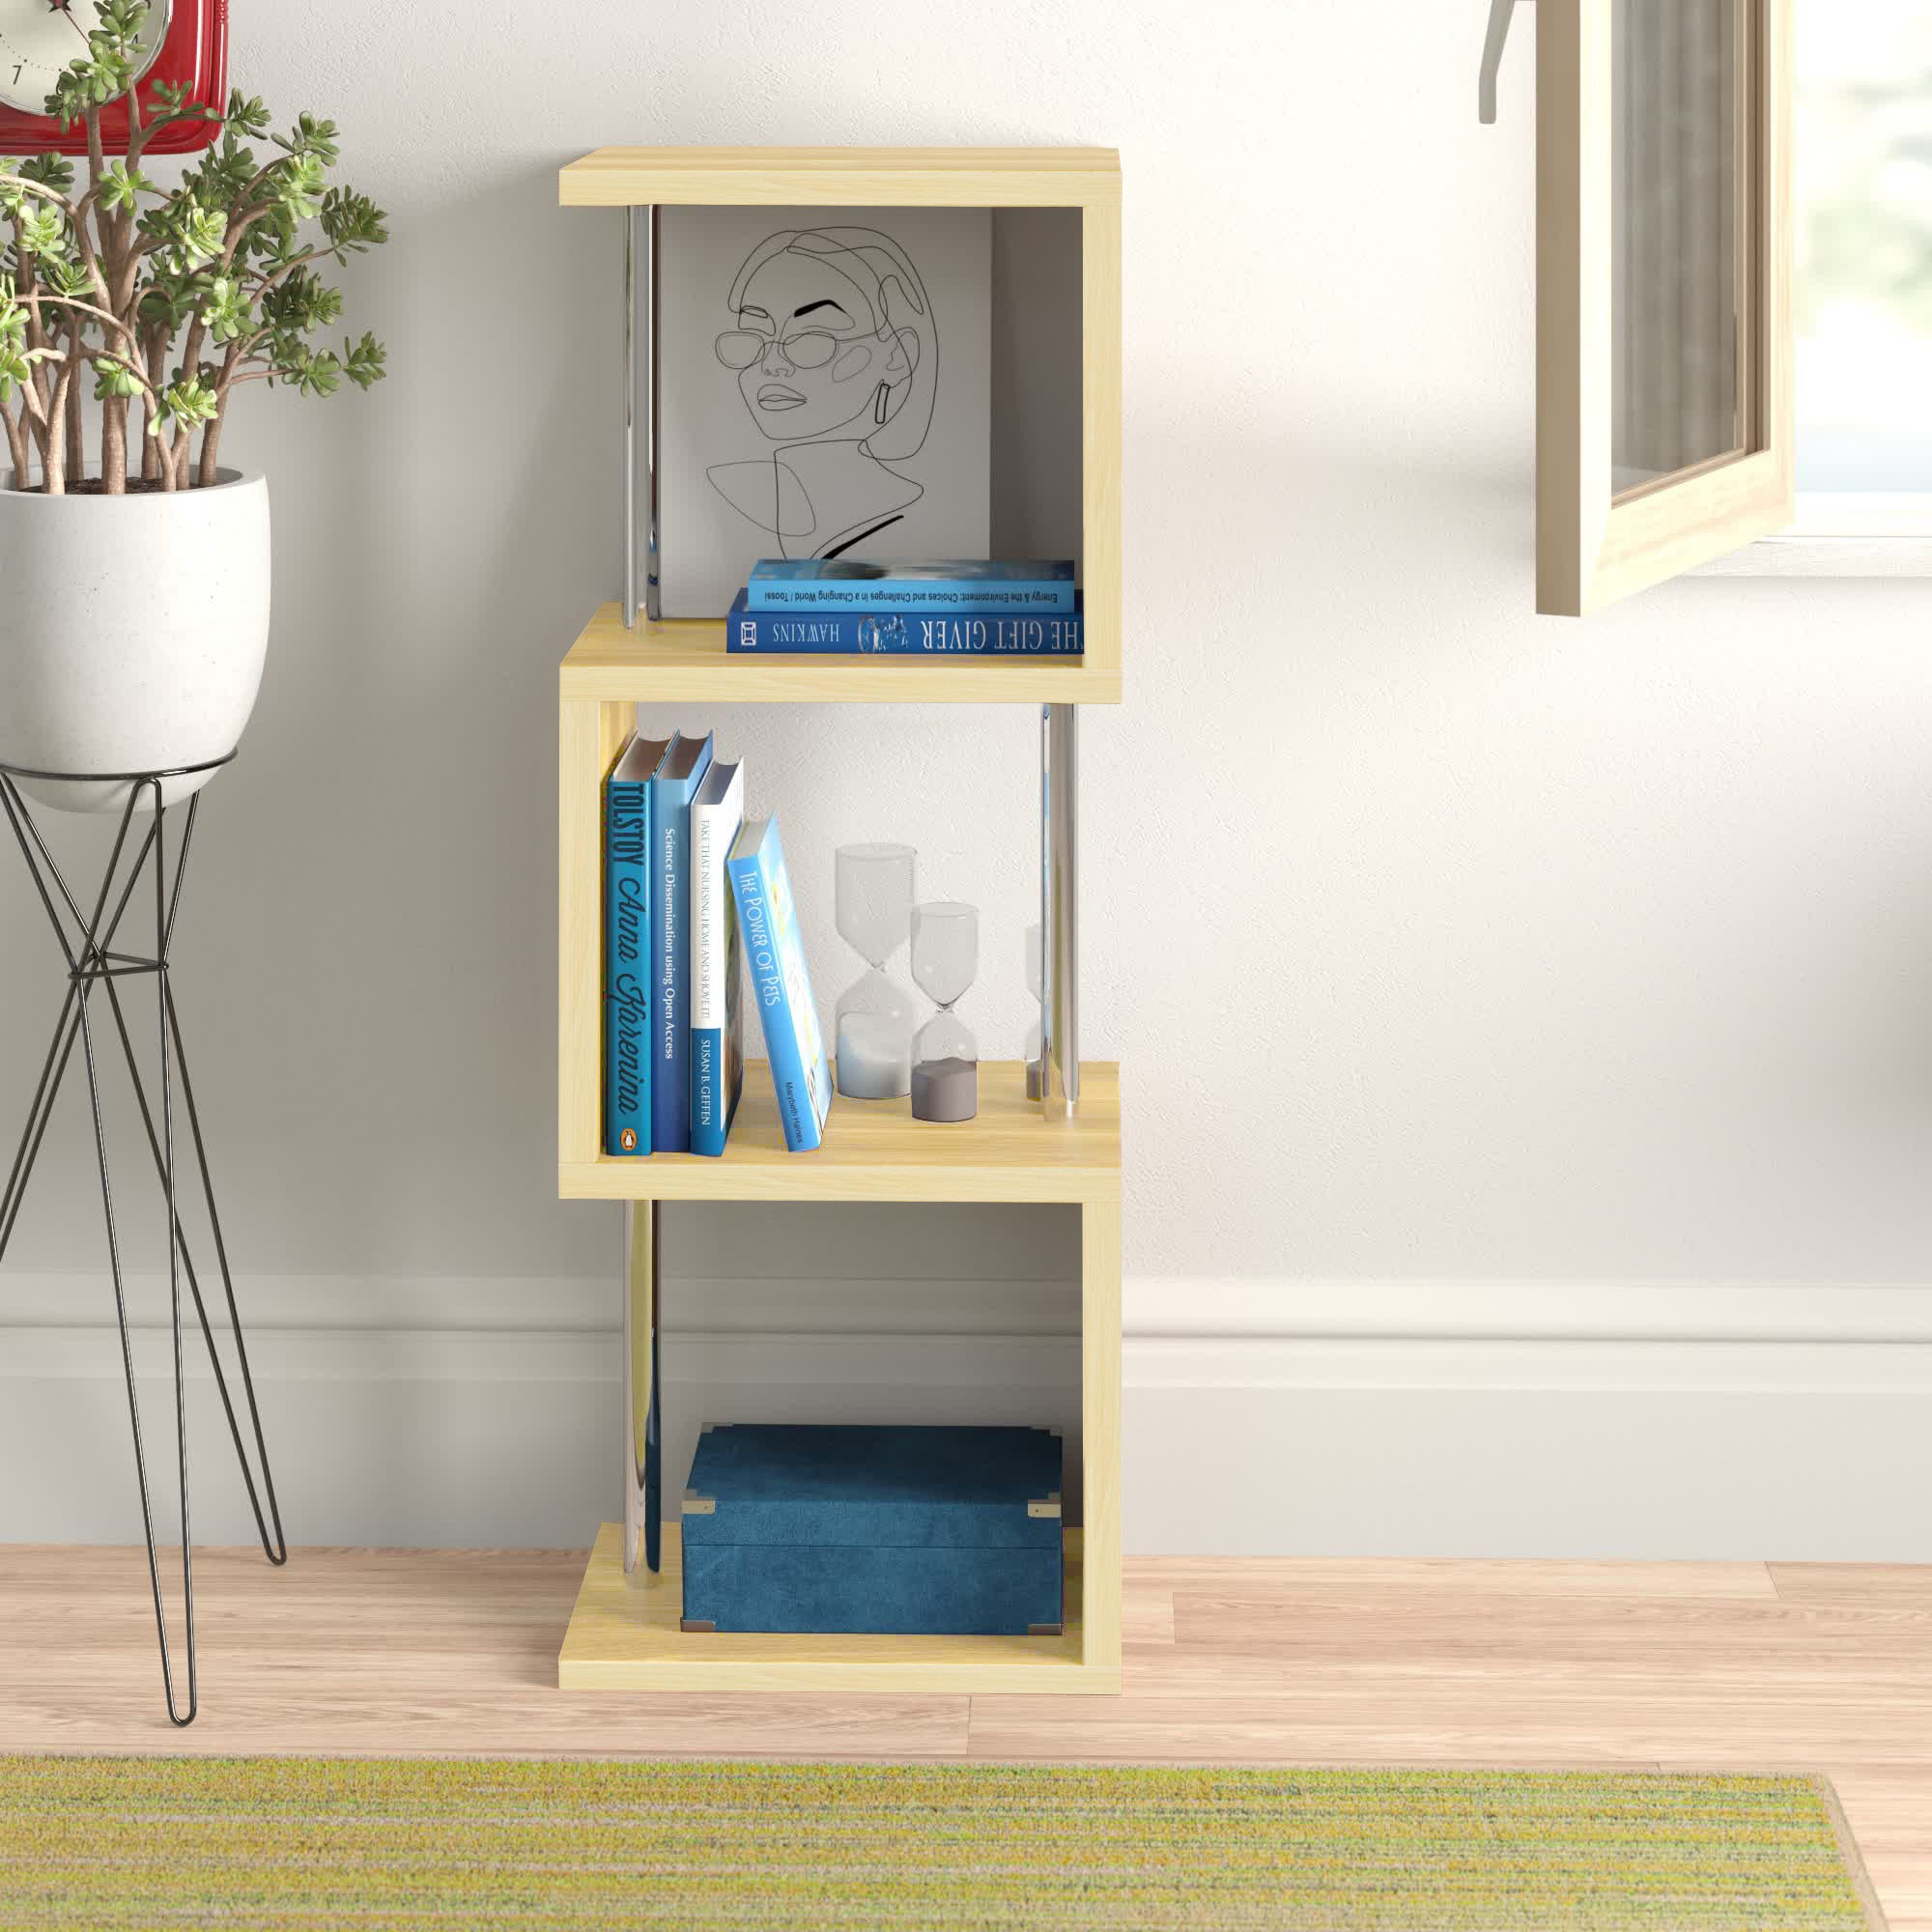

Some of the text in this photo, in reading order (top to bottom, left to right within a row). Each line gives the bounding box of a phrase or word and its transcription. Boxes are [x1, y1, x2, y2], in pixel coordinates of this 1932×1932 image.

[12, 65, 21, 85] 7
[764, 592, 788, 602] Toossi
[795, 591, 816, 603] World
[818, 590, 853, 603] Changing
[862, 592, 868, 602] in
[870, 590, 911, 603] Challenges
[913, 592, 925, 603] and
[928, 592, 958, 603] Choices
[1010, 592, 1022, 603] the
[1024, 592, 1030, 603] &
[1032, 590, 1058, 603] Energy
[773, 620, 1084, 650] HE GIFT GIVER HAWKINS
[701, 819, 710, 842] TAKE
[701, 842, 710, 871] THAT
[701, 871, 710, 917] NURSING
[739, 871, 758, 895] THE
[701, 919, 710, 948] HOME
[744, 896, 768, 948] POWER
[610, 783, 646, 1116] TOLSTOY Anna Karenina
[663, 828, 675, 1060] Science Dissemination using Open Access
[701, 950, 710, 973] AND
[756, 952, 774, 975] OF
[701, 974, 710, 1006] SHOVE
[700, 1039, 711, 1125] SUSAN B. GEFFEN
